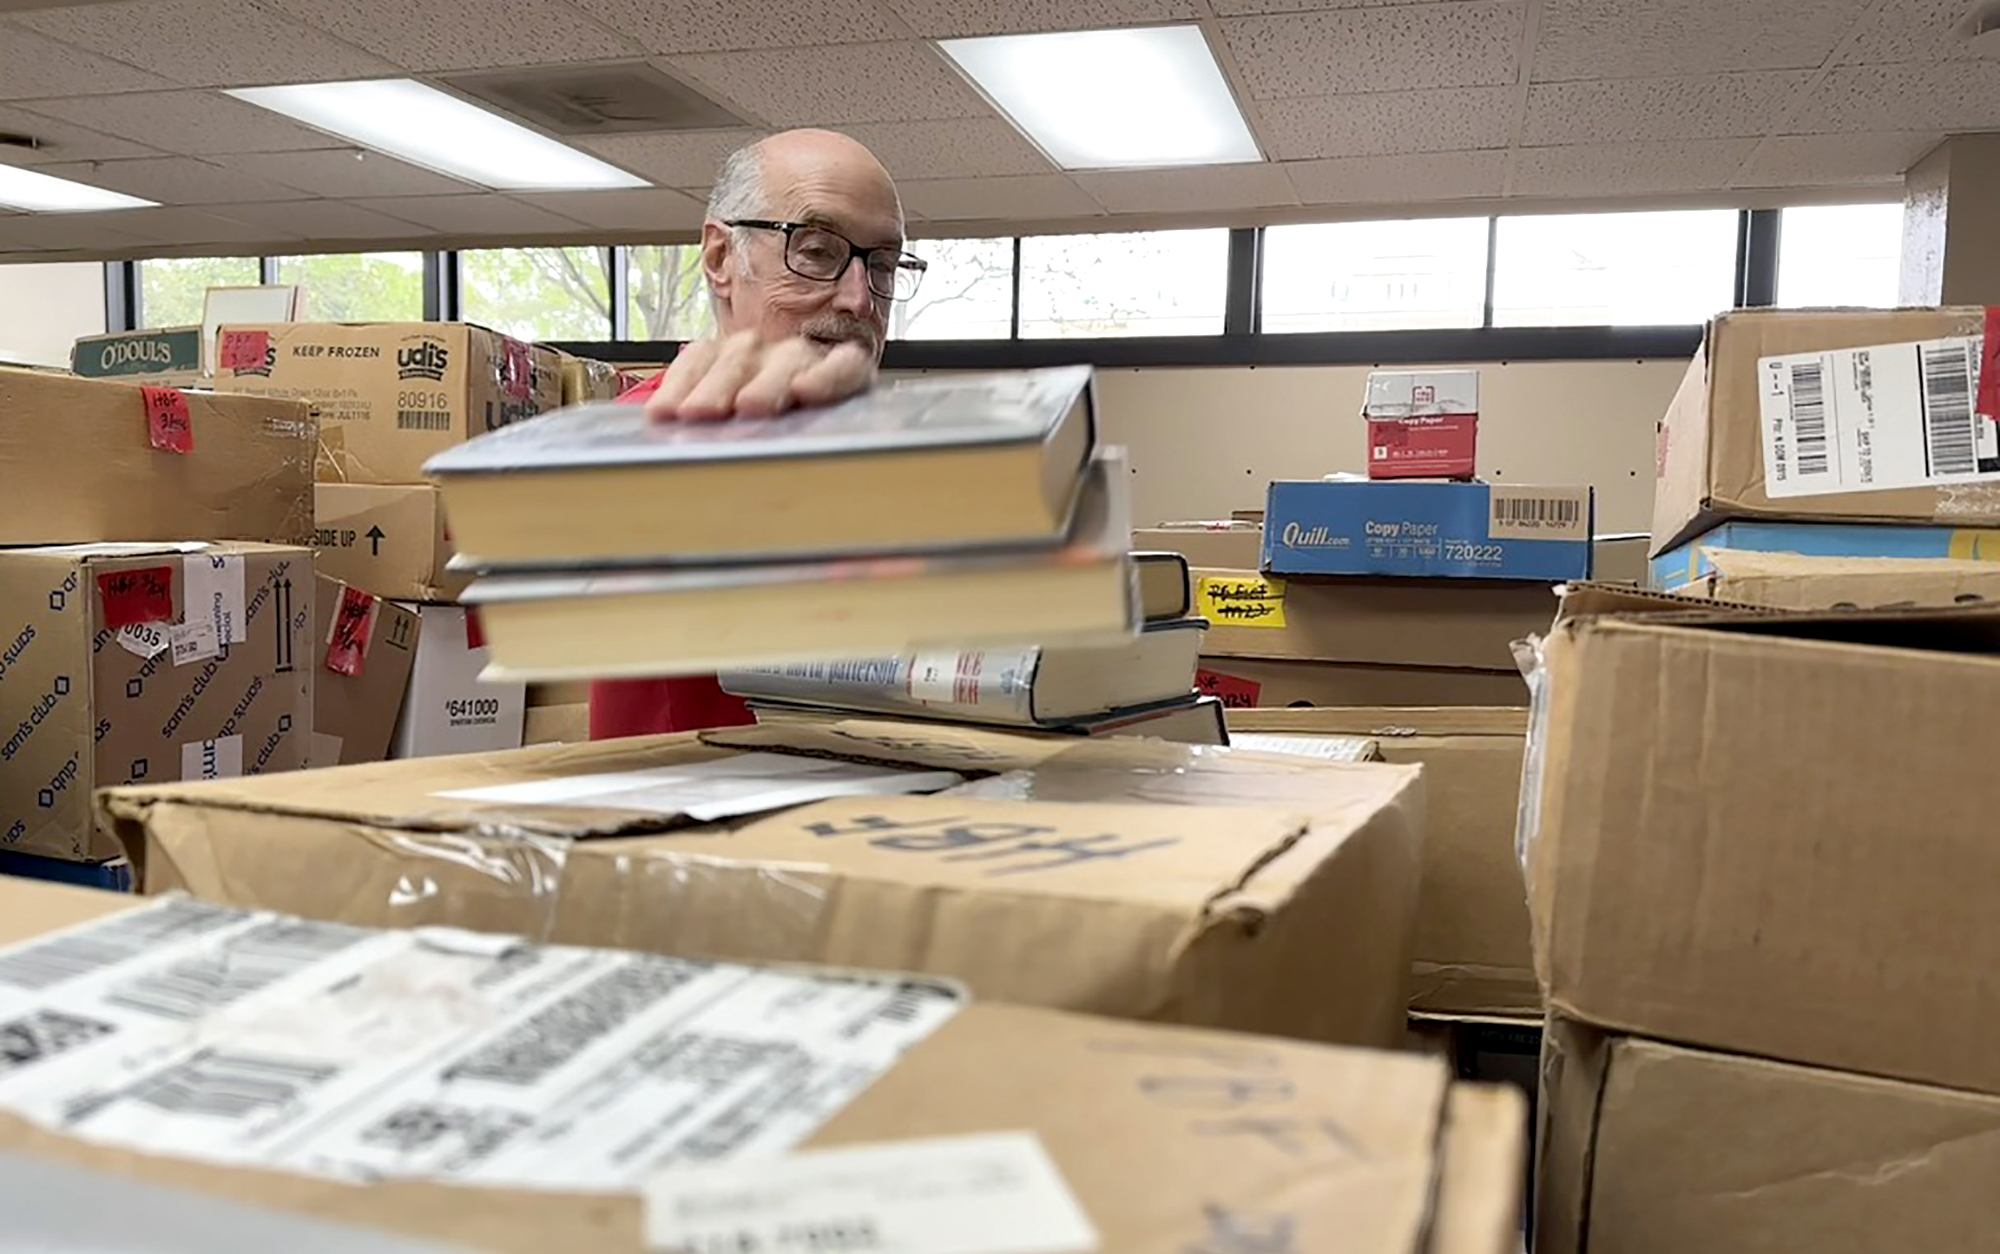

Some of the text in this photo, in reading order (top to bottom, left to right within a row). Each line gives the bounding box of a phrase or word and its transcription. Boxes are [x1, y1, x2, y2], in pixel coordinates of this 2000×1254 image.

[101, 340, 172, 370] O'DOUL'S
[293, 346, 380, 358] KEEP FROZEN
[397, 391, 448, 409] 80916
[313, 529, 338, 548] SIDE
[340, 530, 356, 548] UP
[1282, 521, 1350, 547] Quill.com
[1365, 520, 1438, 536] Copy Paper
[1446, 545, 1502, 561] 720222
[161, 661, 218, 740] sam's club
[233, 675, 263, 720] sam's
[1, 693, 57, 761] sam's club
